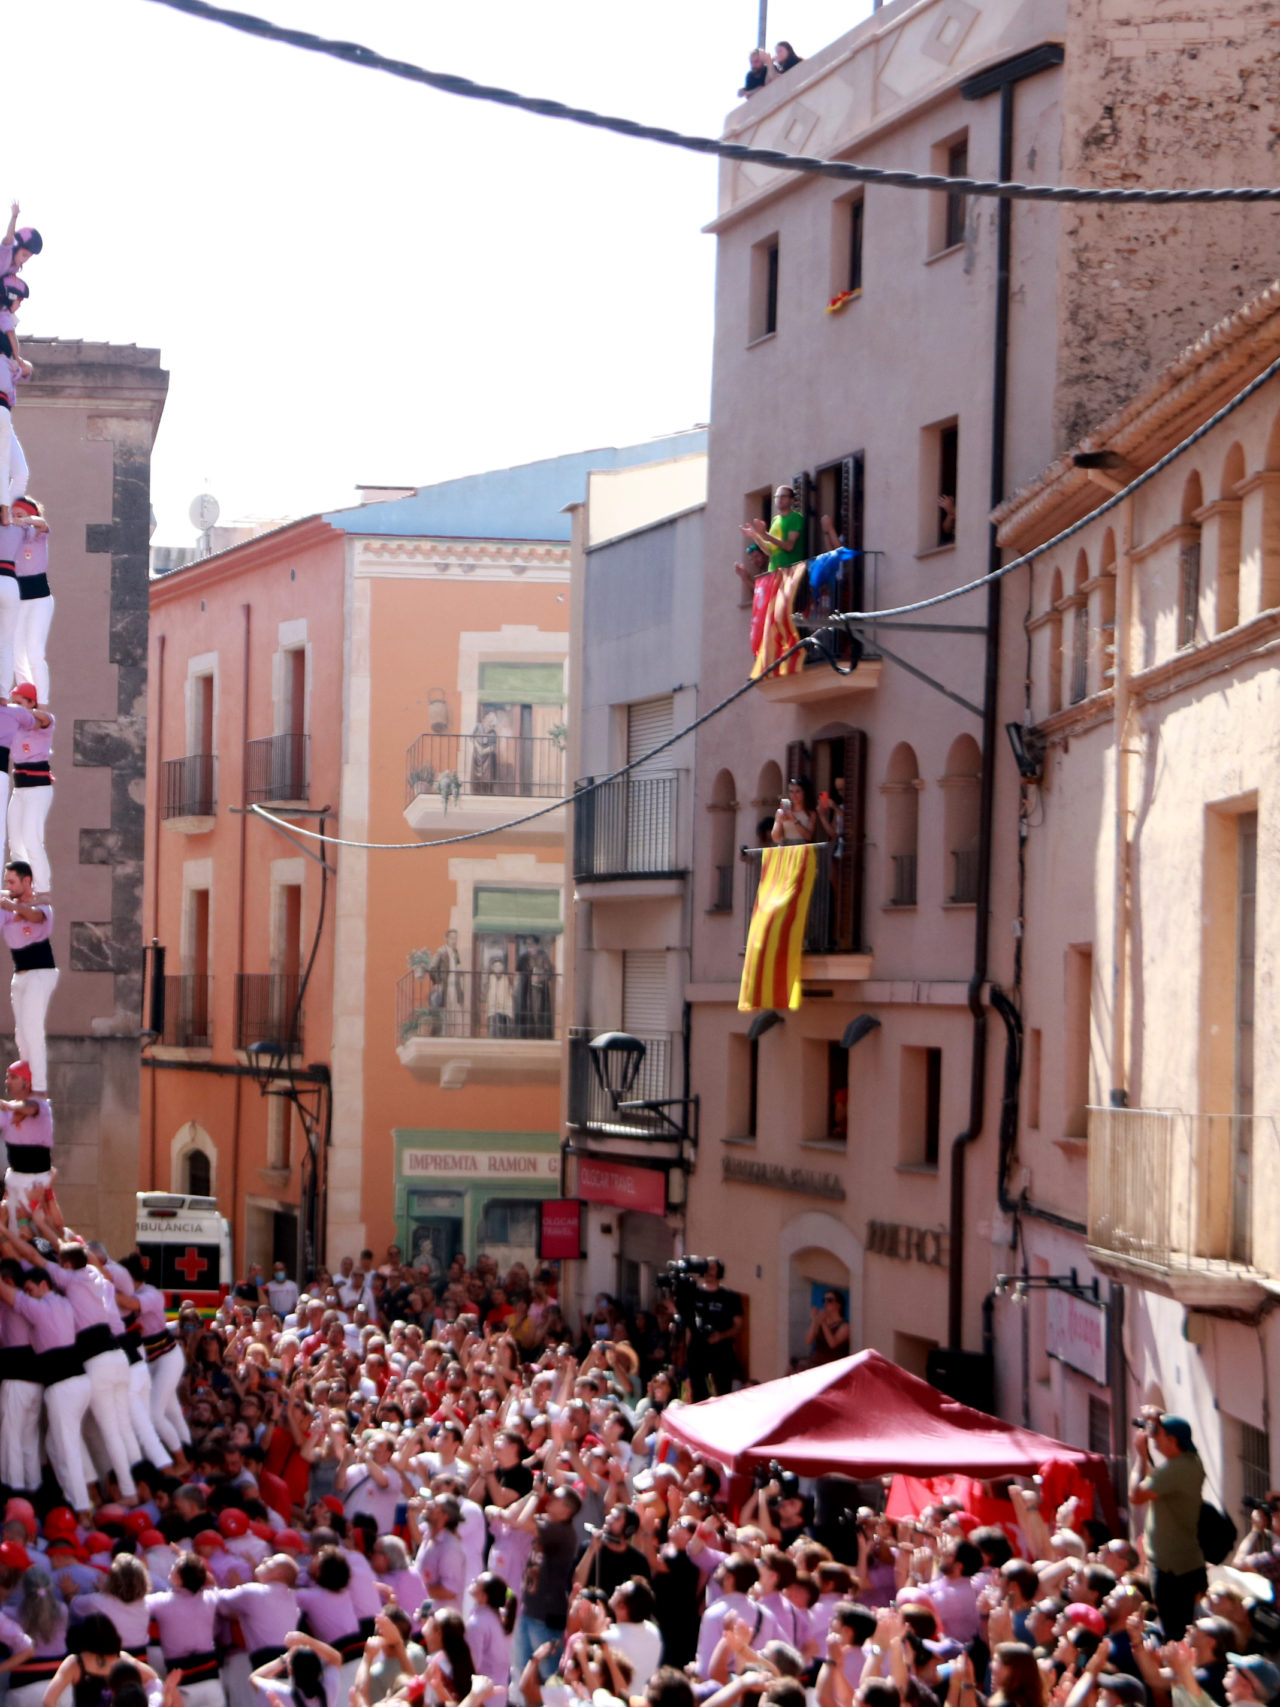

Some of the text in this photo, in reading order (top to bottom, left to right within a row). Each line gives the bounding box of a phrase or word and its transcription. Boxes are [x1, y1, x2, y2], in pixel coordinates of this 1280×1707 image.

[409, 1153, 478, 1171] IMPREMTA
[488, 1156, 537, 1173] RAMON
[136, 1221, 203, 1232] BULÀNCIA
